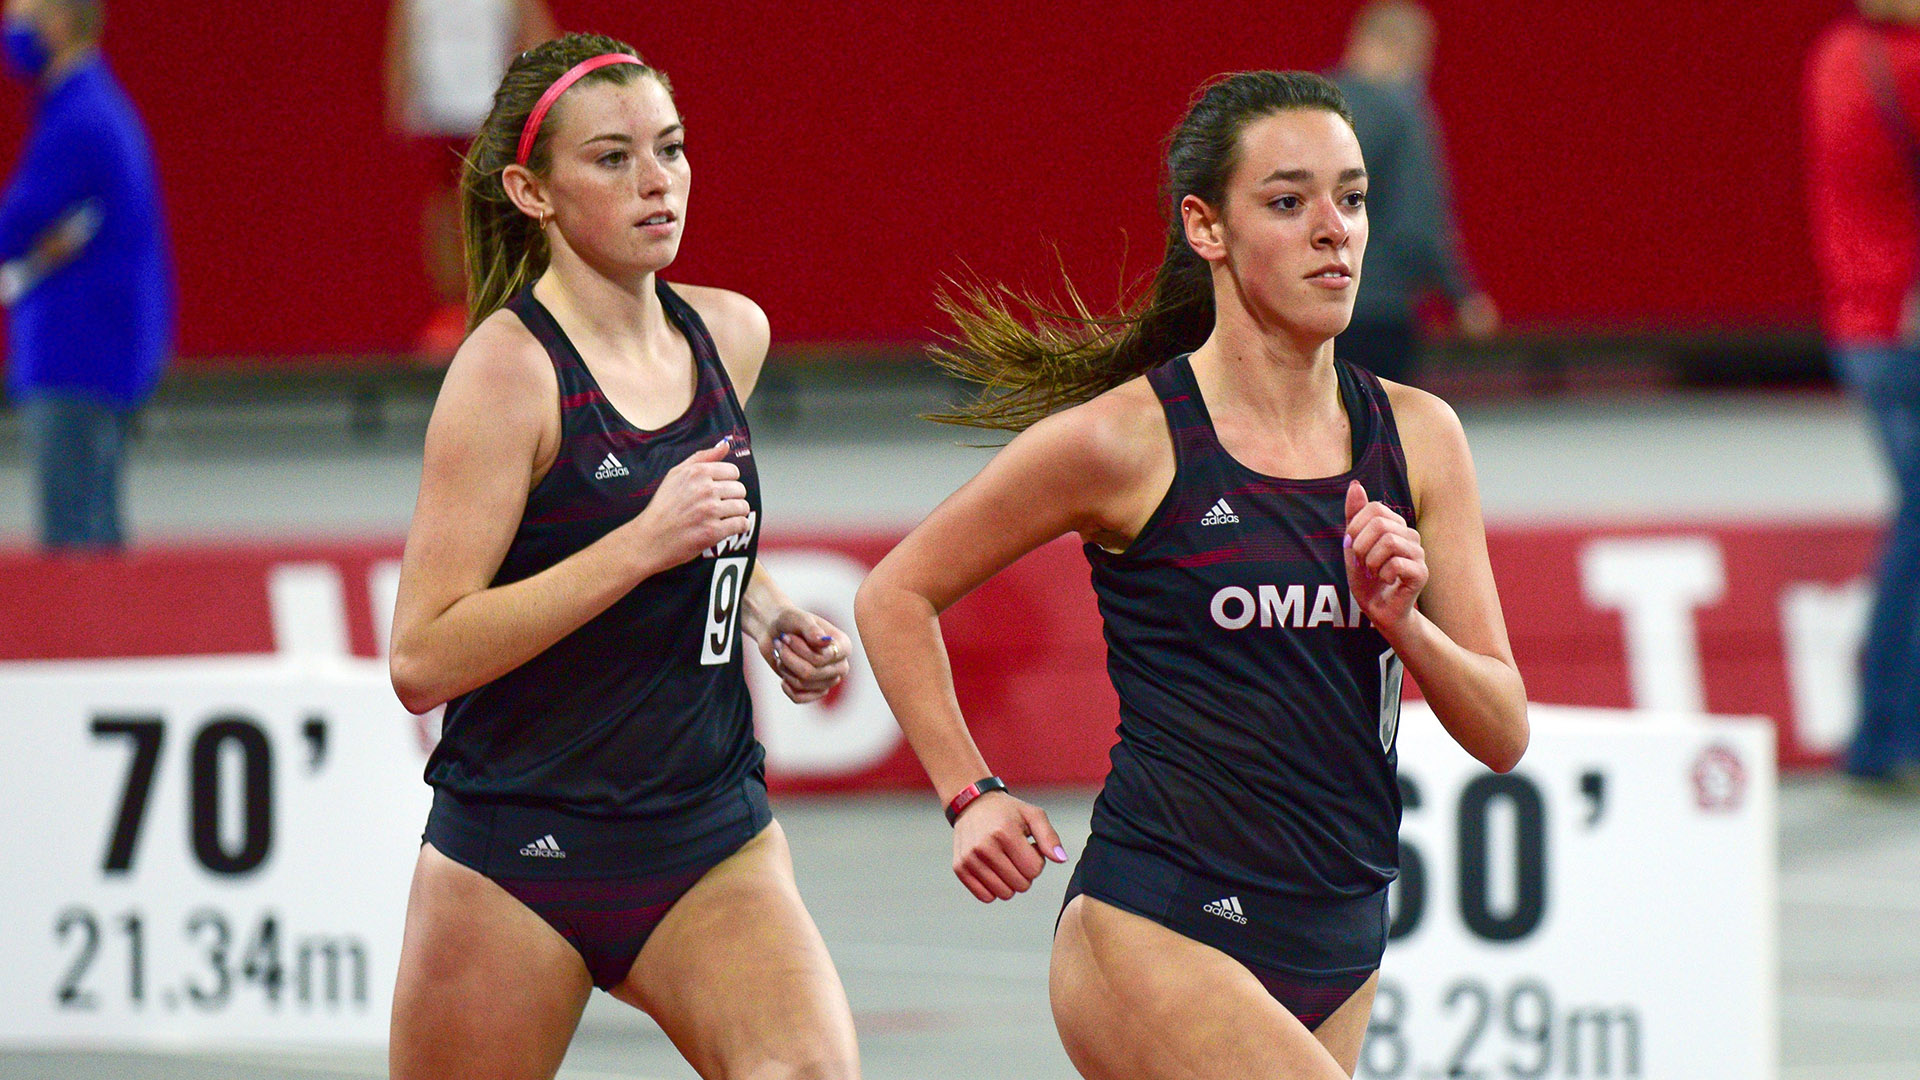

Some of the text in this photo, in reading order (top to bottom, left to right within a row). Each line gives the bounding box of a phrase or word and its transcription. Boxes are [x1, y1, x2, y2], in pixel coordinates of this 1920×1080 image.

[594, 467, 630, 480] adidas
[1201, 514, 1240, 526] adidas
[710, 563, 738, 656] 9
[519, 847, 566, 859] adidas
[1203, 904, 1248, 925] adidas
[54, 907, 370, 1010] 21.34m
